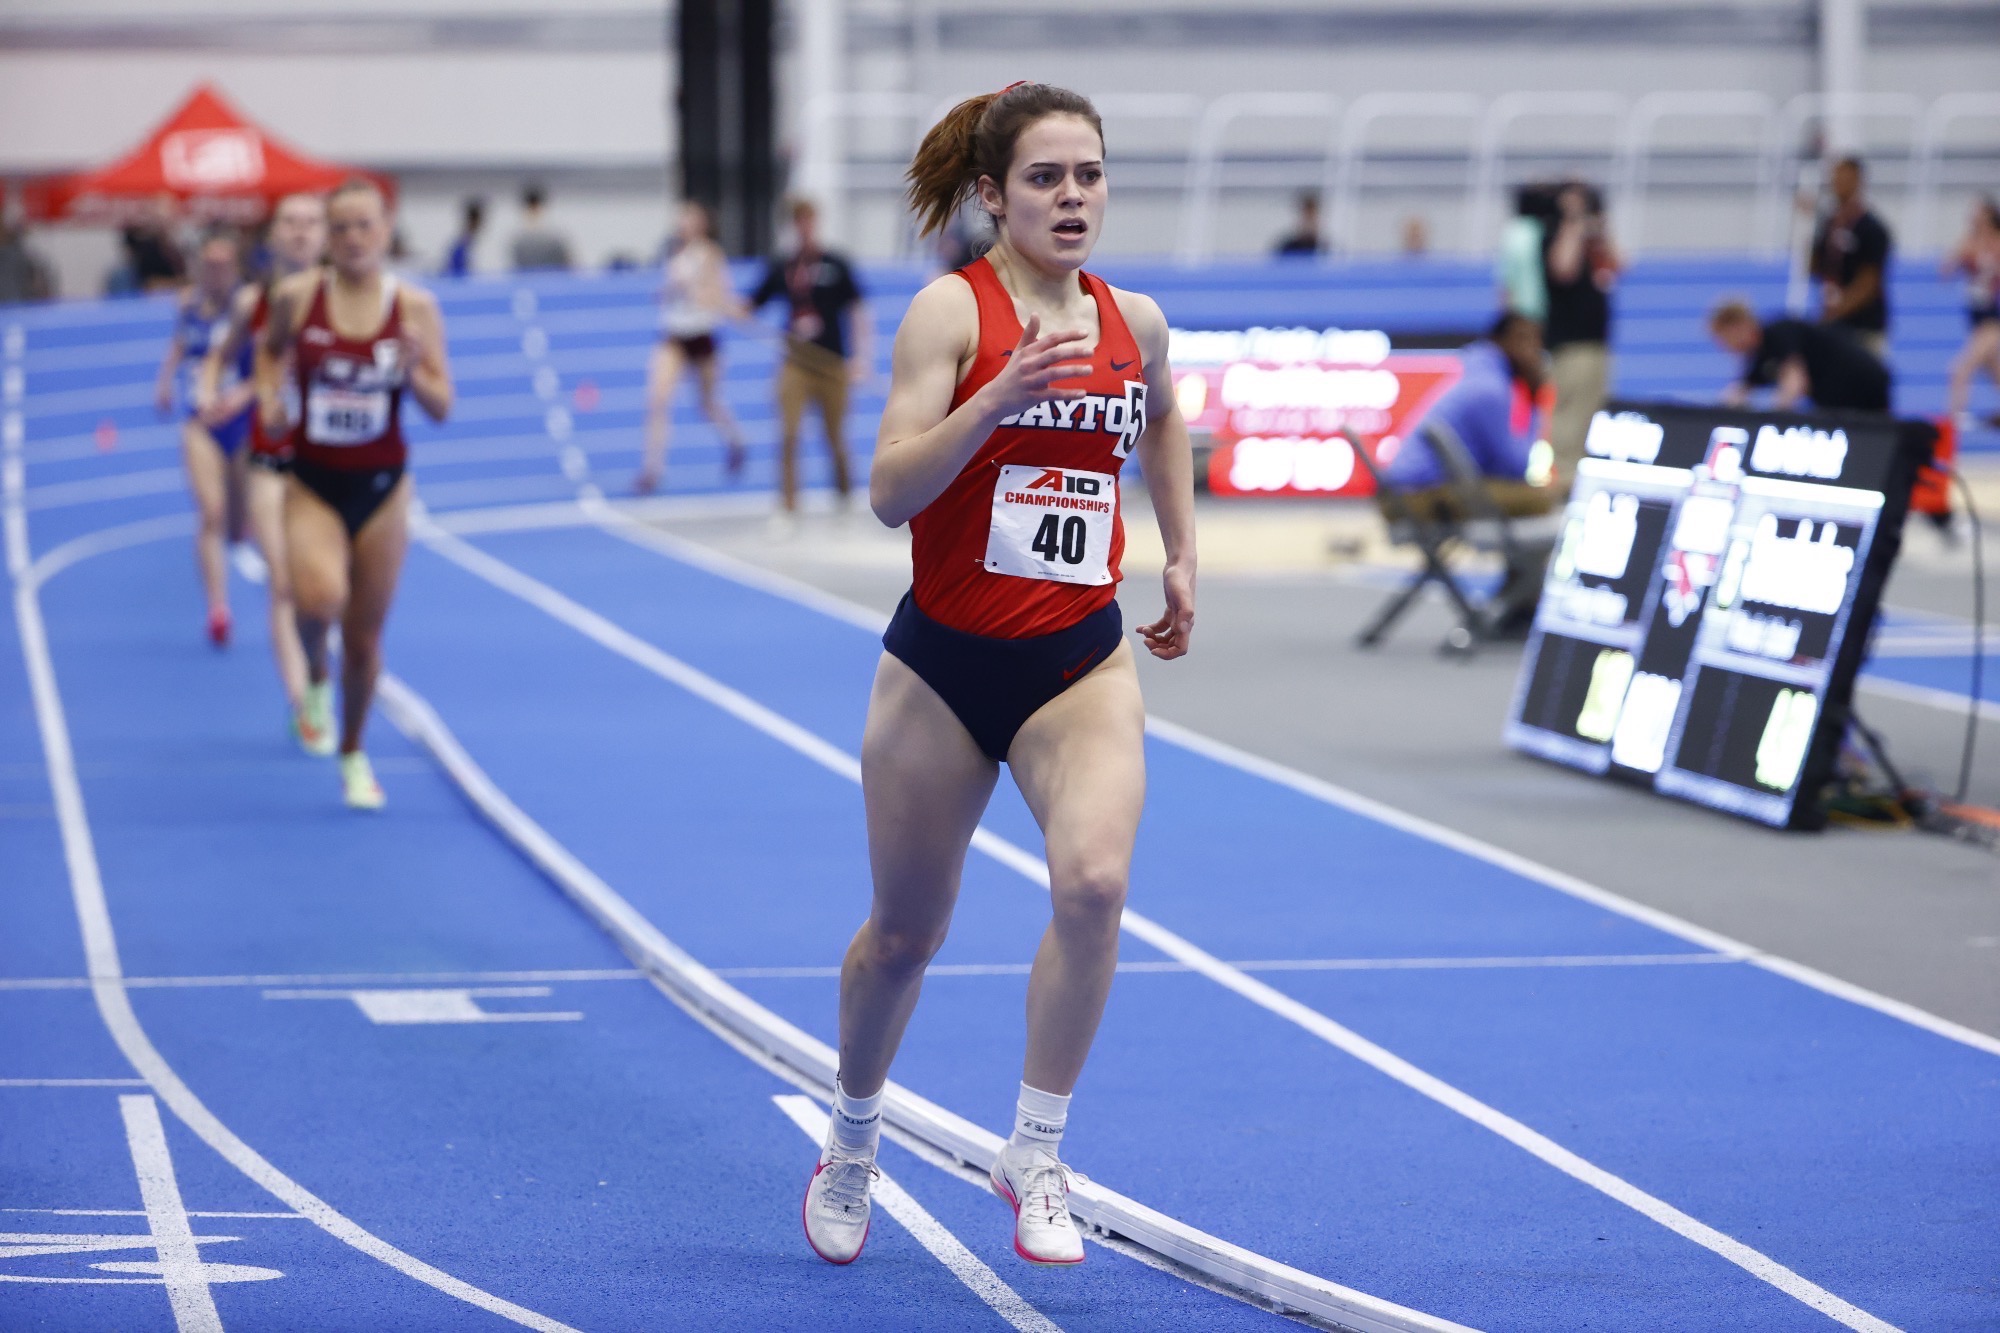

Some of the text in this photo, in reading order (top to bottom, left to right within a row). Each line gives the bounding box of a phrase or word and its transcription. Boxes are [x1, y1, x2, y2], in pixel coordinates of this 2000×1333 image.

[999, 396, 1127, 434] AYTO
[1122, 387, 1145, 454] 5
[1025, 468, 1100, 496] A10
[1004, 491, 1110, 514] CHAMPIONSHIPS
[1031, 513, 1087, 565] 40
